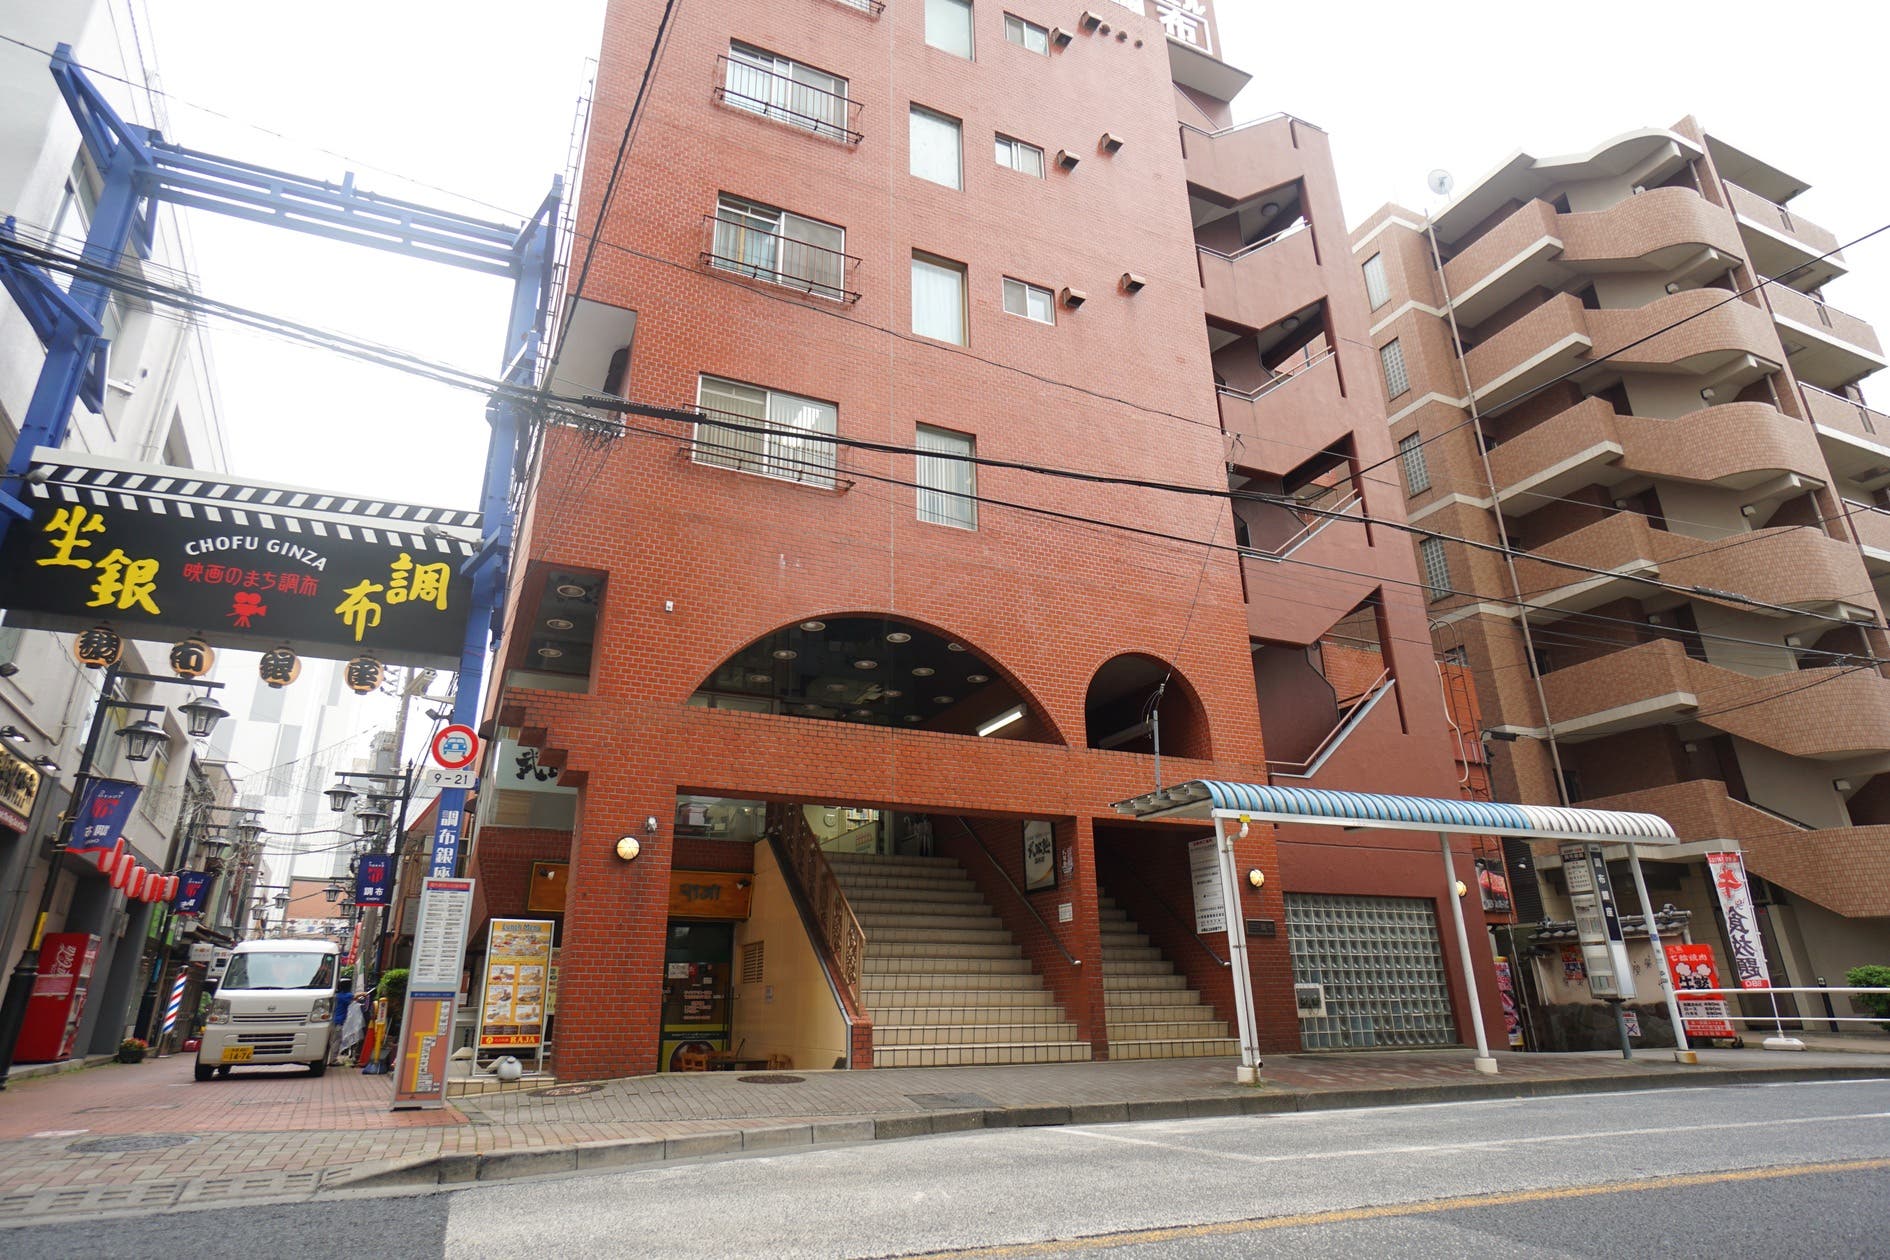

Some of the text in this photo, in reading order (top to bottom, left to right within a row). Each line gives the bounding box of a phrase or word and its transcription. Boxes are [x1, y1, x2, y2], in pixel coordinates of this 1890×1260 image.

[185, 535, 328, 571] CHOFU GINZA
[182, 563, 318, 597] 映画のまち調布
[434, 773, 468, 785] 9-21
[433, 810, 459, 878] 調布銀座
[363, 887, 384, 896] 調布
[502, 923, 521, 932] Lunch
